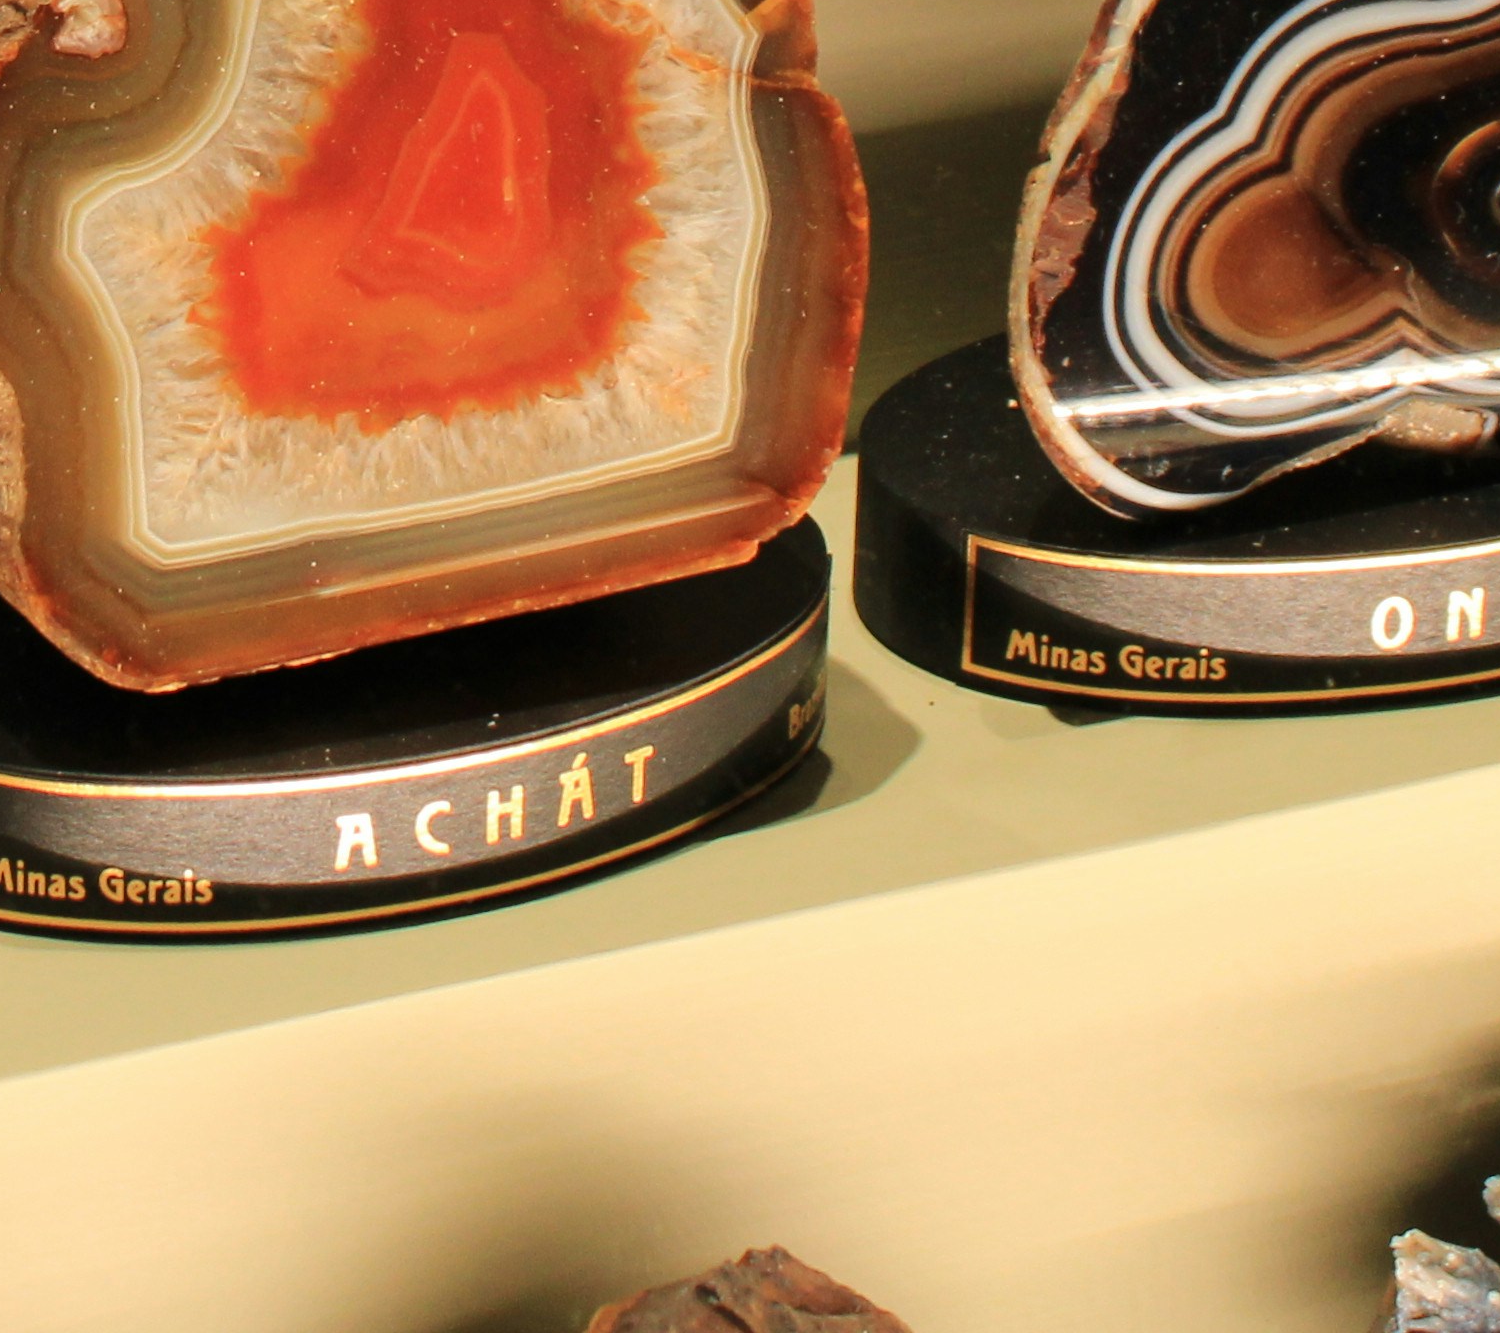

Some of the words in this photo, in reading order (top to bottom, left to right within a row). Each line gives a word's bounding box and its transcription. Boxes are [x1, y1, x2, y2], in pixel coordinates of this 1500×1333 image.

[1006, 630, 1106, 673] Minas
[1120, 644, 1226, 680] Gerais
[335, 746, 655, 870] ACHÁT
[99, 866, 213, 905] Gerais
